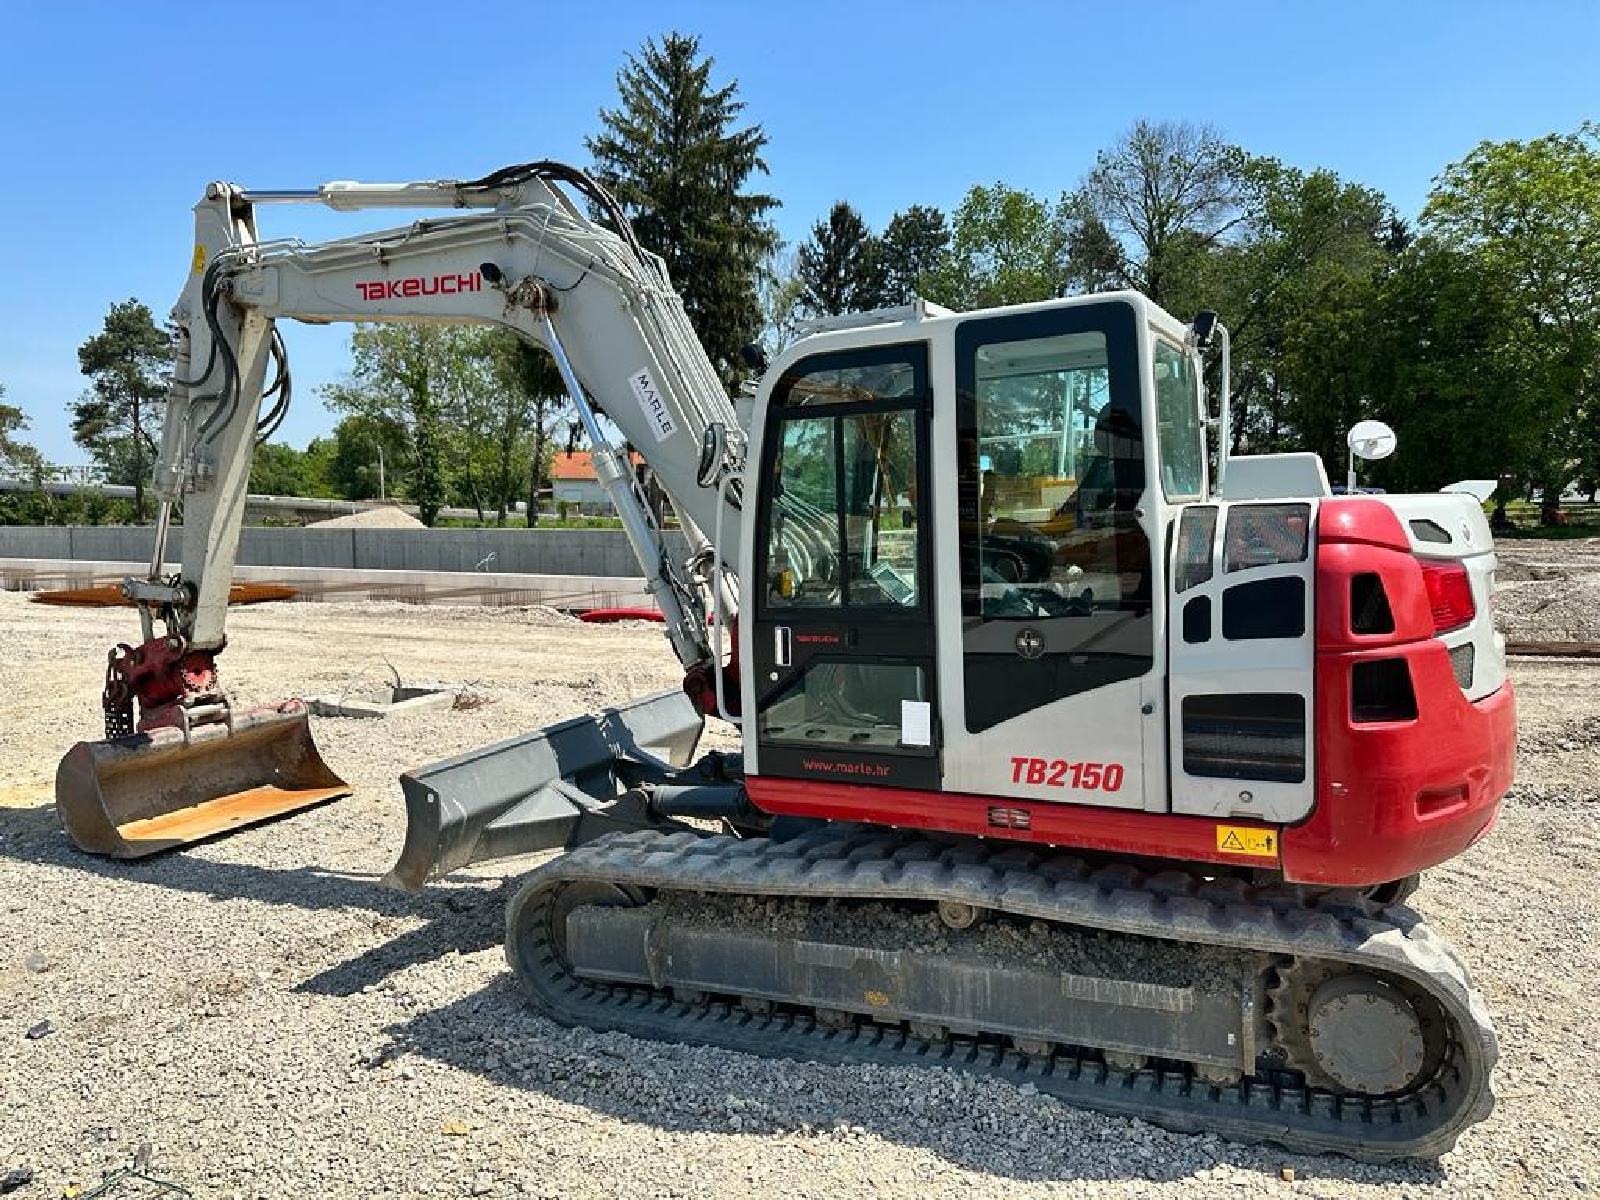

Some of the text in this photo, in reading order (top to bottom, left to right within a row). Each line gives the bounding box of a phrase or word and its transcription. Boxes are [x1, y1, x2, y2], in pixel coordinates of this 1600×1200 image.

[638, 374, 672, 433] MARLE
[804, 760, 890, 776] www.marle.hr
[1011, 757, 1124, 791] TB2150
